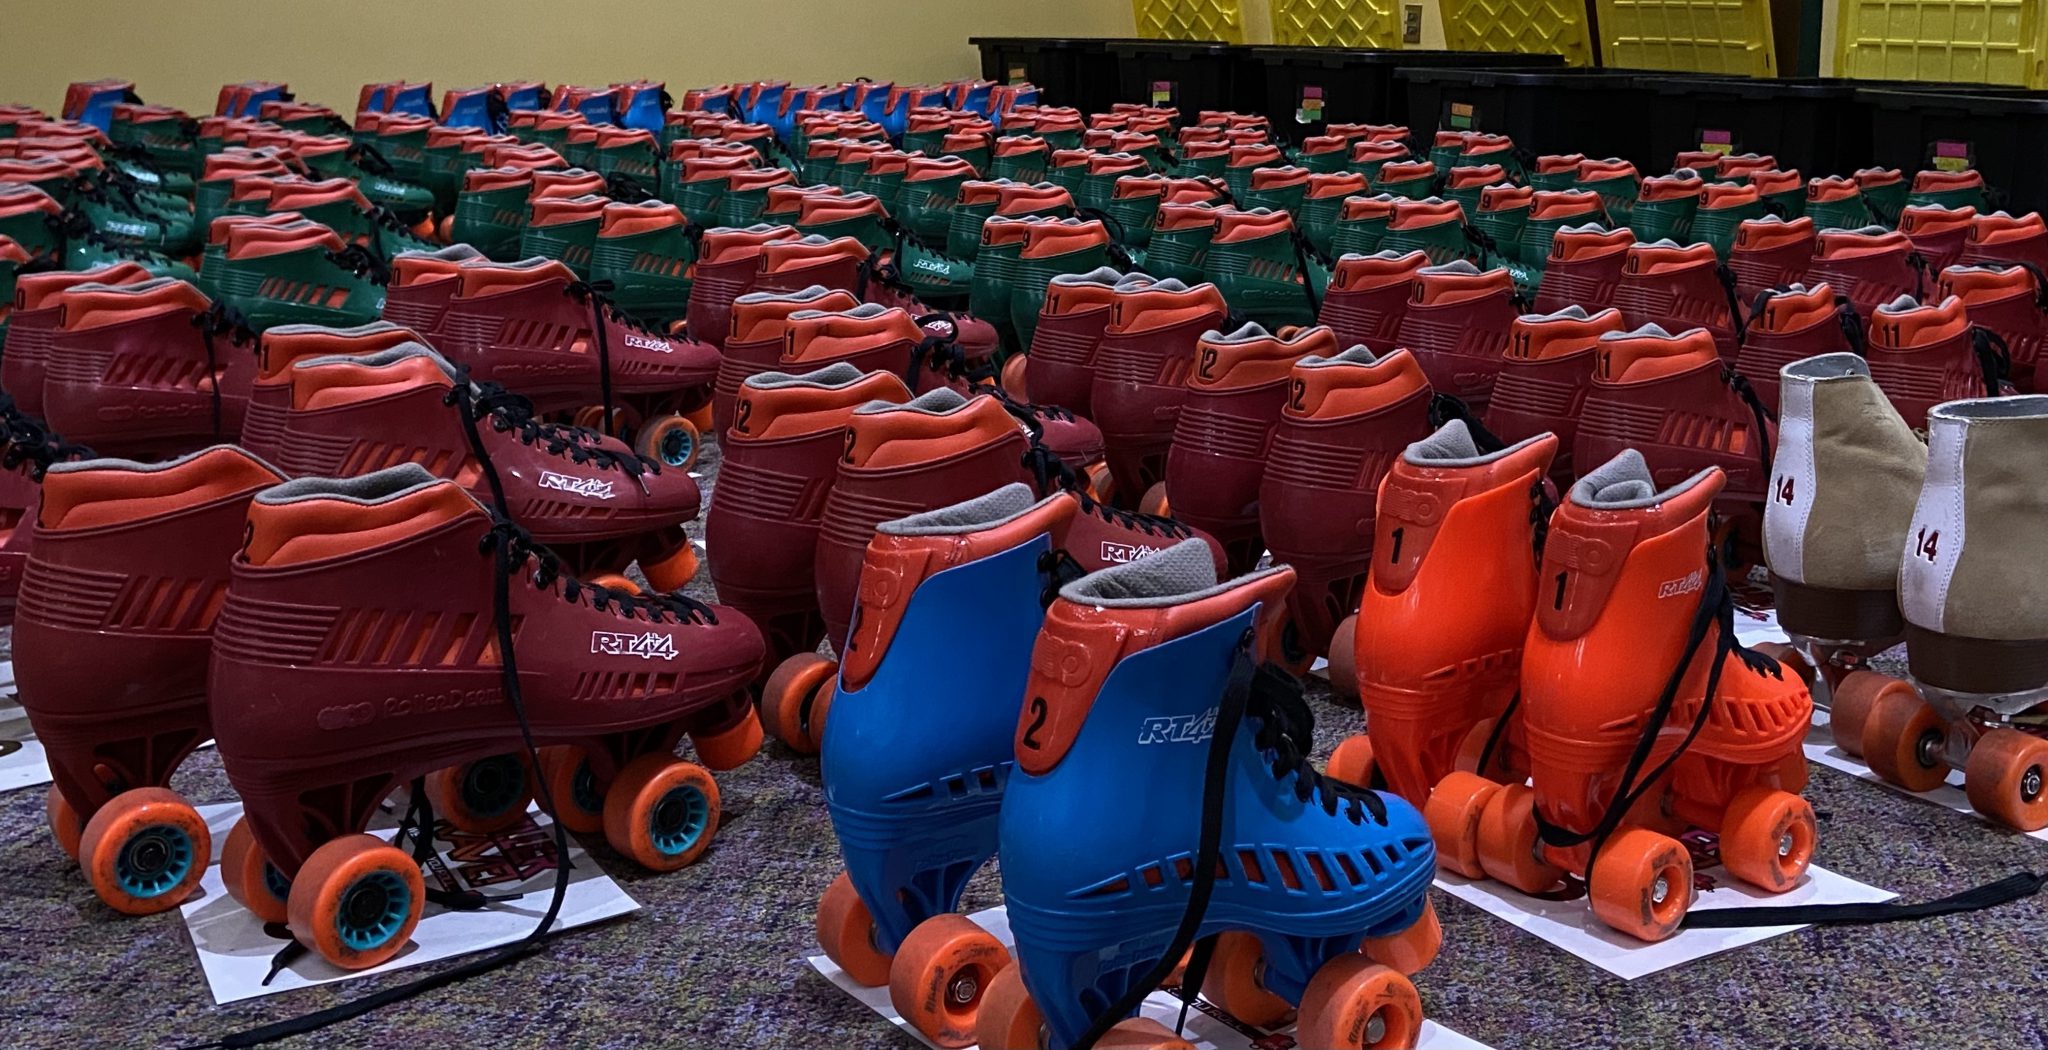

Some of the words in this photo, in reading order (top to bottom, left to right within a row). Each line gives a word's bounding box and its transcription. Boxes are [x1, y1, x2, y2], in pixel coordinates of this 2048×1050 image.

[1482, 192, 1492, 208] 9
[1642, 183, 1652, 197] 9
[1700, 191, 1709, 205] 9
[1809, 185, 1819, 198] 9
[1157, 211, 1166, 227] 9
[982, 229, 992, 246] 9
[1022, 230, 1031, 249] 9
[1046, 293, 1060, 315] 11
[1513, 330, 1531, 358] 11
[1881, 323, 1901, 348] 11
[1199, 347, 1218, 379] 12
[1288, 378, 1306, 411] 12
[734, 398, 752, 434] 12
[1775, 474, 1795, 506] 14
[1391, 527, 1404, 564] 1
[1916, 526, 1940, 563] 14
[1553, 570, 1569, 611] 1
[1022, 697, 1048, 750] 2
